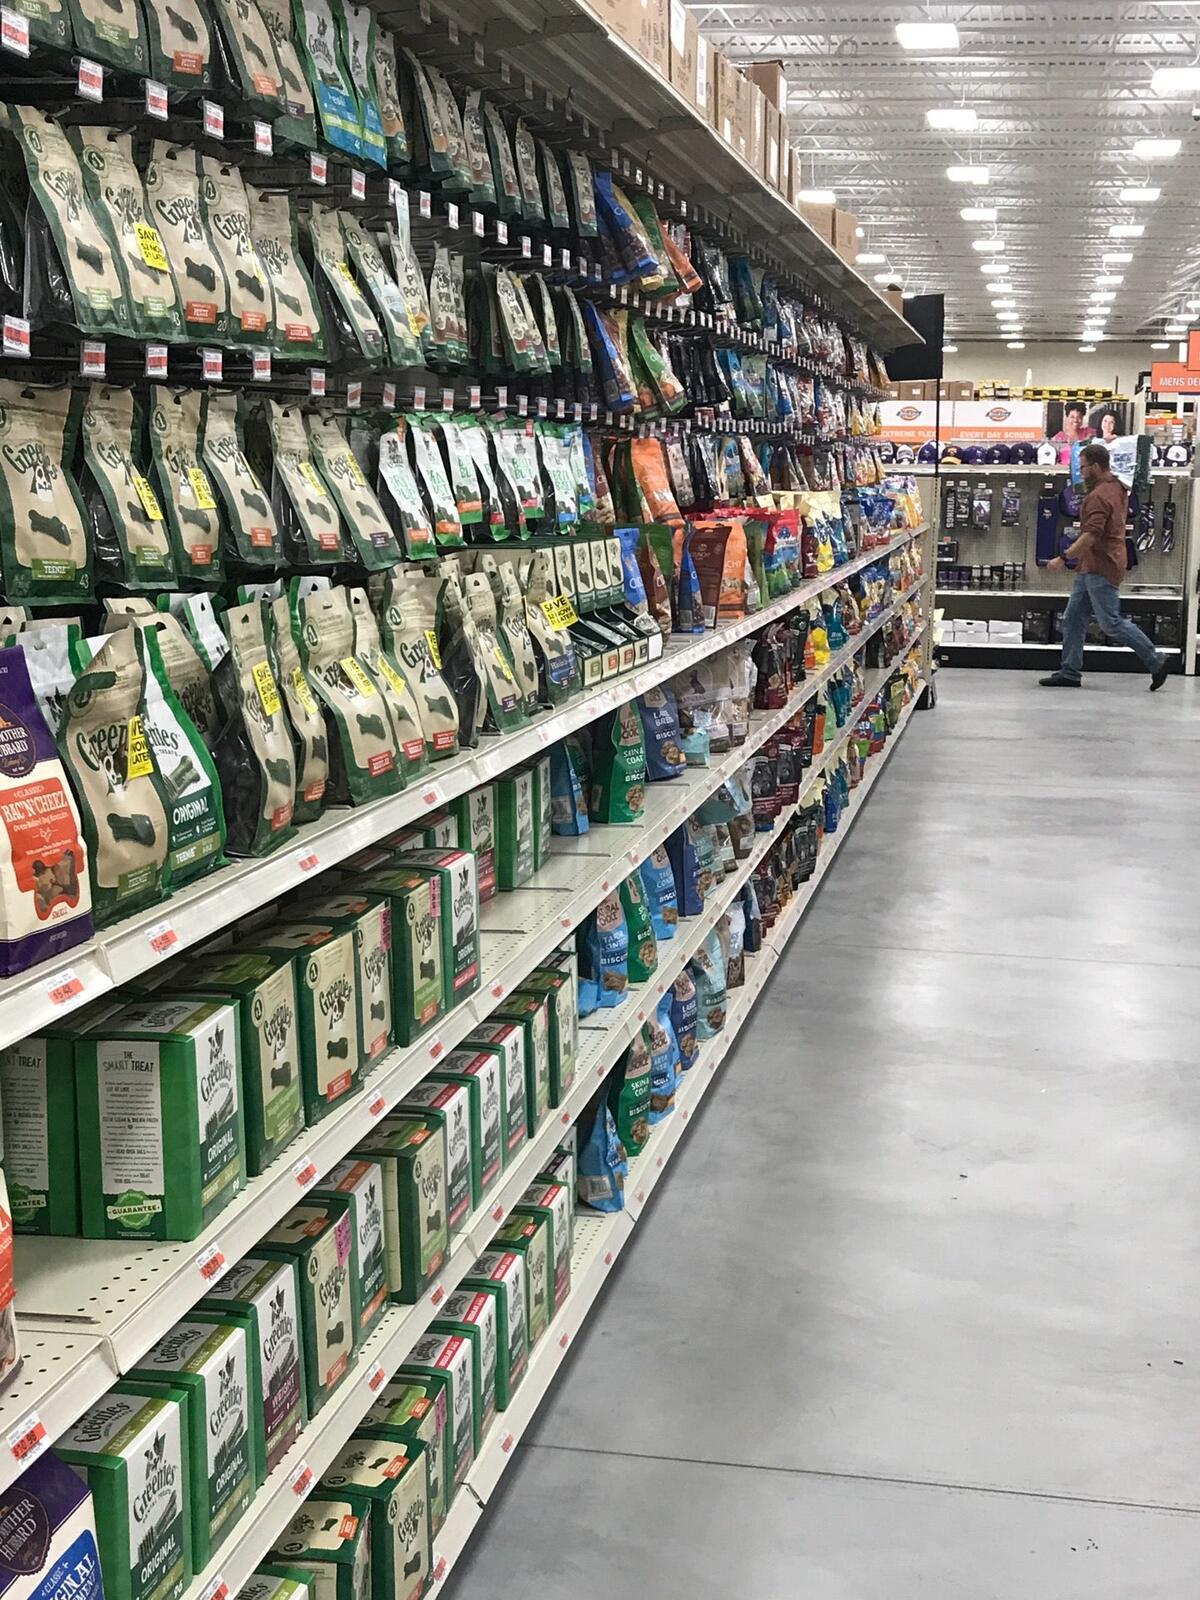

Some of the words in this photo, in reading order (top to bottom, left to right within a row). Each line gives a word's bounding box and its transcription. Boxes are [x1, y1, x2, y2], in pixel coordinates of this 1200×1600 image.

[1160, 376, 1185, 386] MENS
[1187, 377, 1200, 386] DE
[960, 431, 985, 439] EVERY
[987, 431, 1001, 439] DAY
[1004, 431, 1036, 439] SCRUBS
[0, 727, 28, 744] OTHER
[173, 796, 209, 826] ORIGINAL
[18, 1057, 42, 1069] TREAT
[103, 1060, 129, 1072] SMART
[131, 1062, 154, 1073] TREAT
[124, 1051, 133, 1060] THE
[200, 1054, 233, 1102] Greenies
[207, 1127, 234, 1163] ORIGINAL
[111, 1204, 157, 1215] GUARANTEE
[263, 1311, 294, 1362] Greenies
[73, 1401, 132, 1444] Greenies
[210, 1379, 244, 1437] Greenies
[215, 1450, 244, 1493] ORIGINAL
[133, 1460, 176, 1524] Greenies
[49, 1553, 96, 1600] GINAL
[140, 1533, 176, 1584] ORIGINAL
